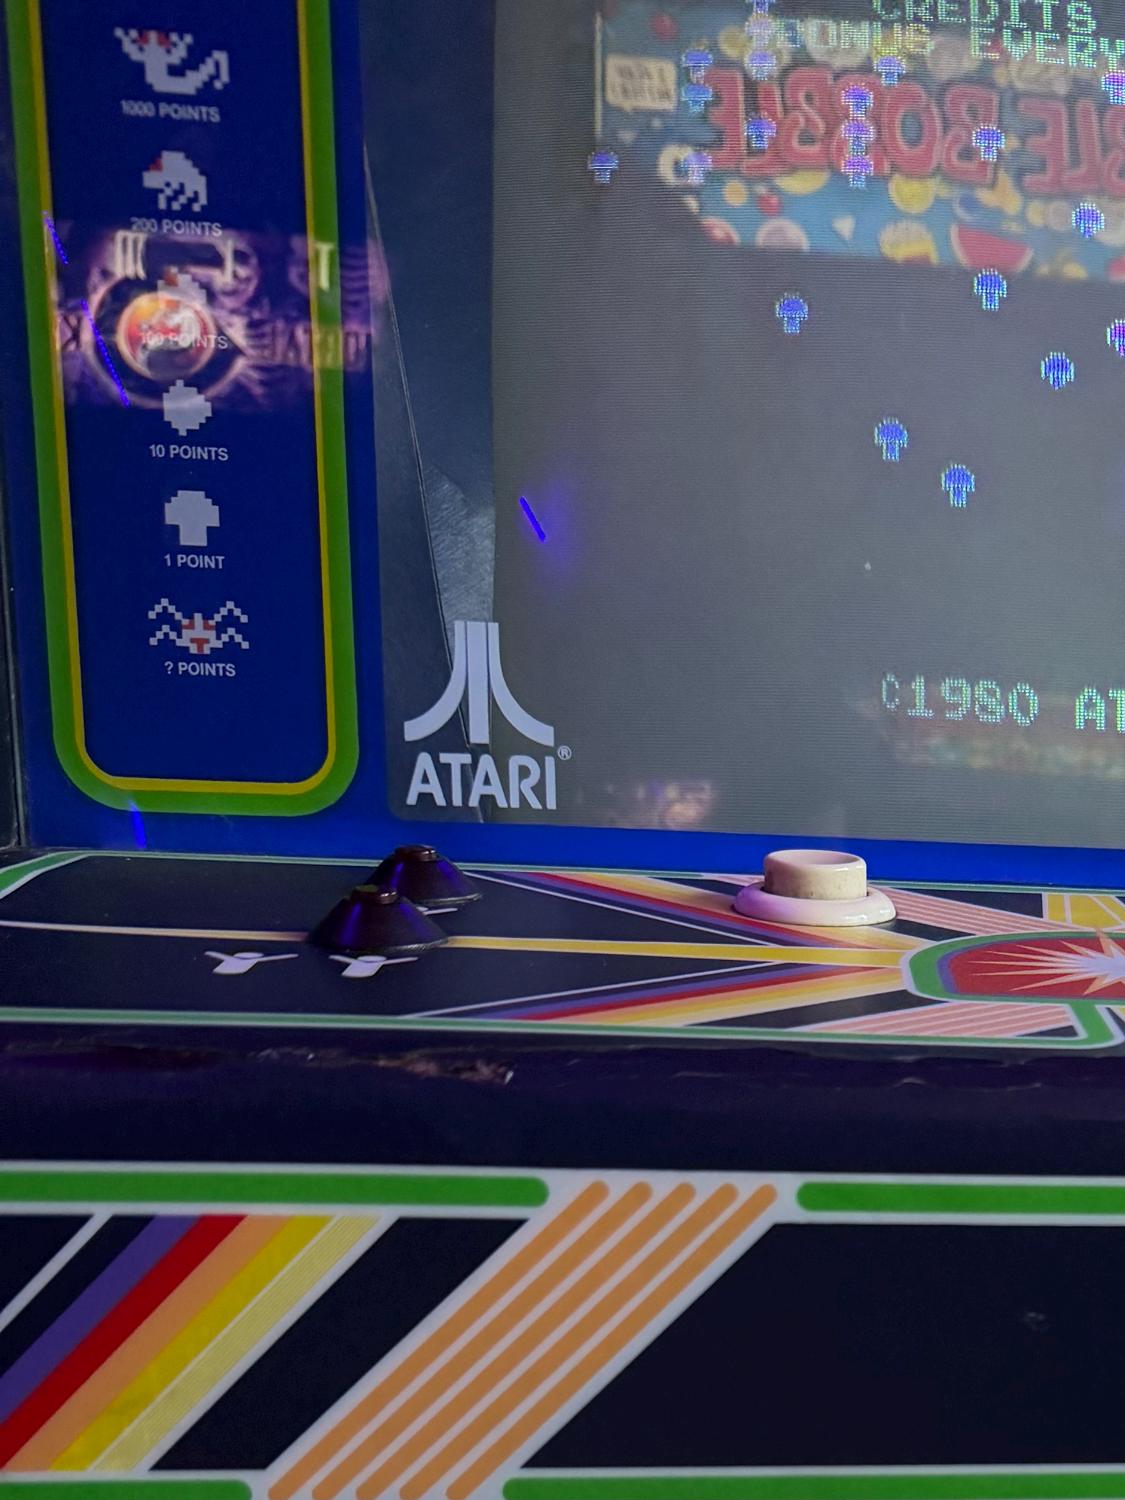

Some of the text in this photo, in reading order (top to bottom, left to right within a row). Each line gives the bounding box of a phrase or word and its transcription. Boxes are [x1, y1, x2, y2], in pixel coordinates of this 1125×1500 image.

[875, 0, 1097, 35] CREDITS
[971, 26, 1125, 72] EVERY
[158, 102, 221, 123] POINTS
[130, 217, 222, 237] 200 POINTS
[149, 444, 229, 462] 10 POINTS
[164, 553, 226, 570] 1 POINT
[164, 661, 236, 677] ? POINTS
